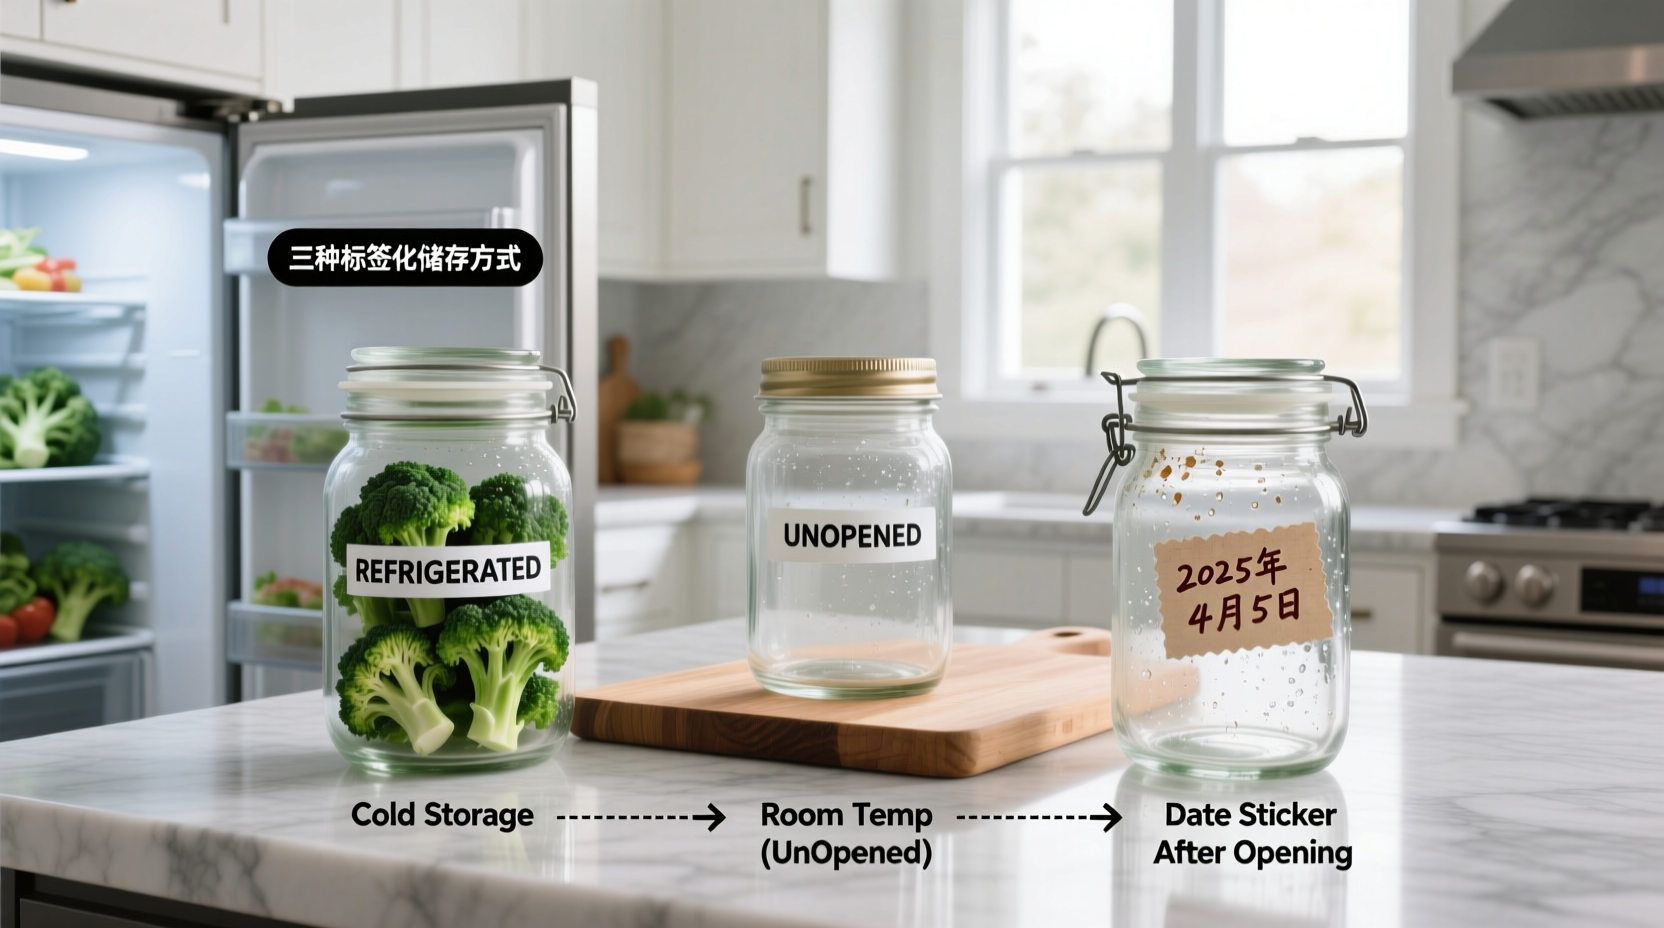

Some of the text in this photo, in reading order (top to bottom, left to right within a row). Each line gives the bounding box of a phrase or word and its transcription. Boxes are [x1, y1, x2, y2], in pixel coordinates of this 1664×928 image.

[784, 522, 922, 549] UNOPENED
[355, 555, 542, 585] REFRIGERATED
[1176, 546, 1288, 594] 2025年
[1188, 587, 1300, 635] 4月5日
